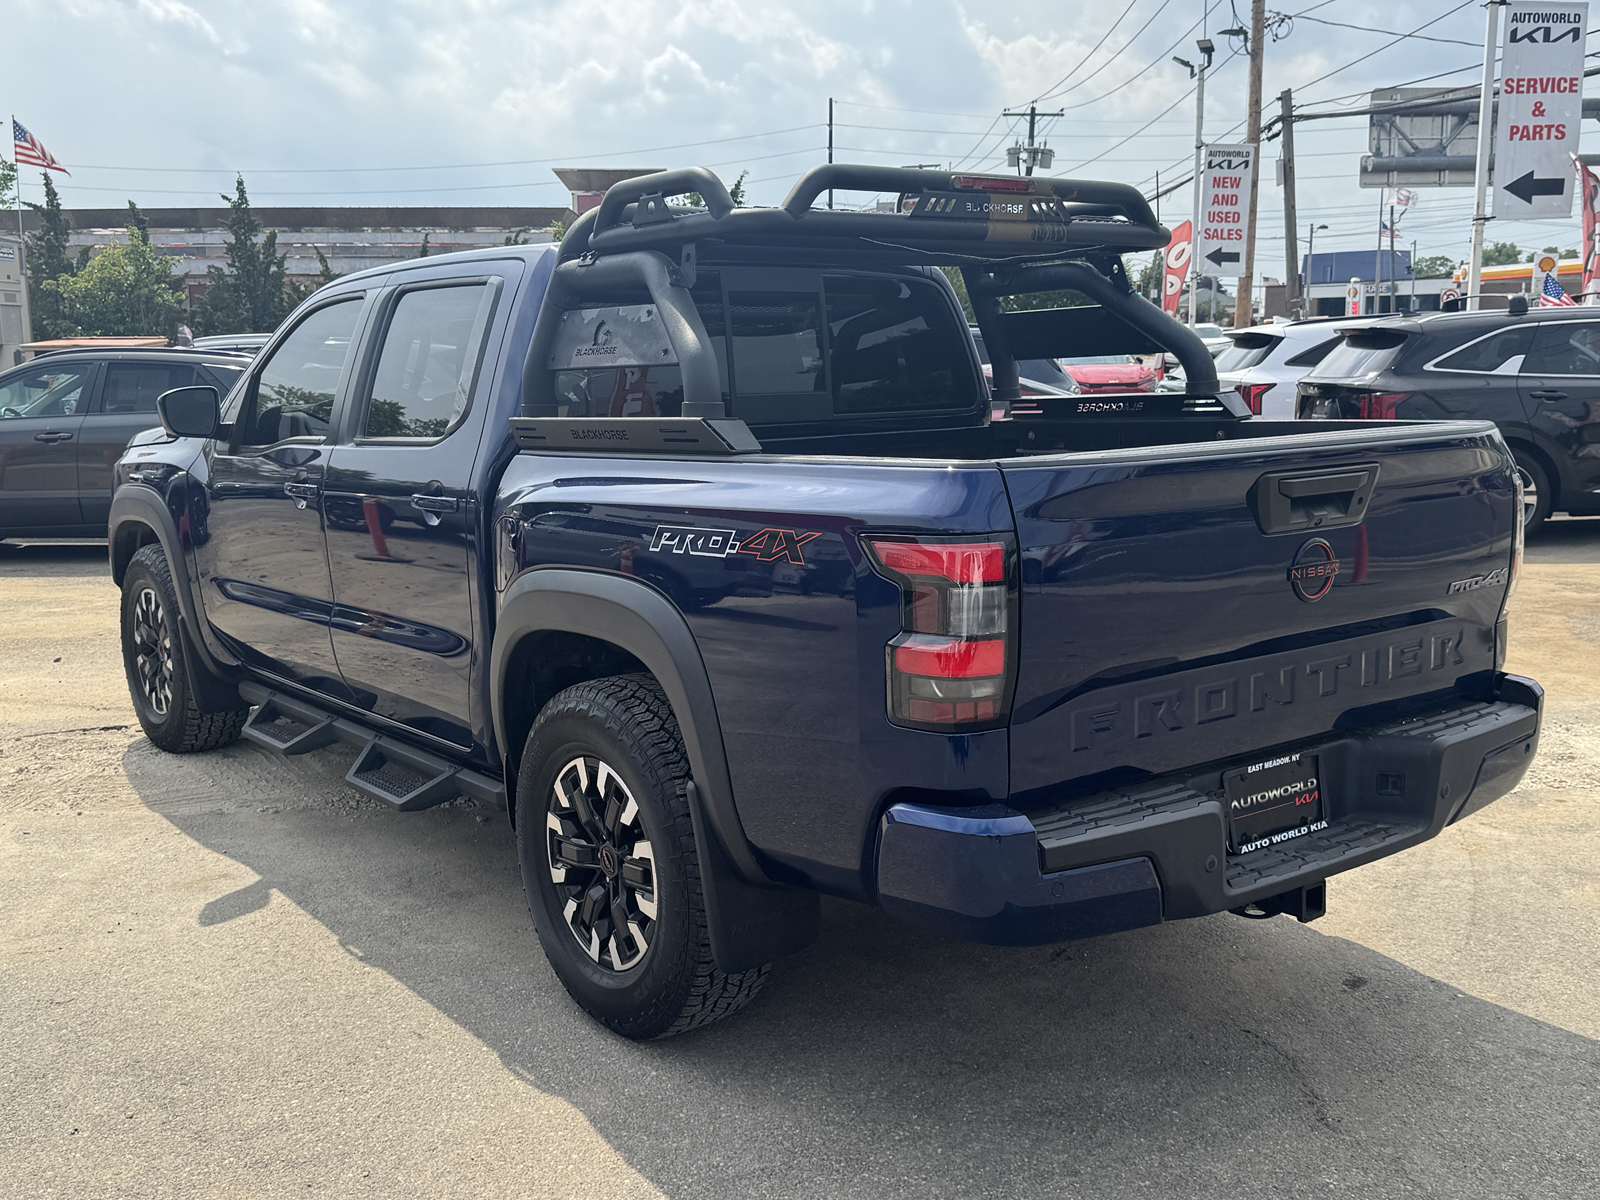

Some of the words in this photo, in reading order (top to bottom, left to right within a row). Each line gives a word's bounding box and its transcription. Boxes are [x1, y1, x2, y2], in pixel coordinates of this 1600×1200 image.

[1511, 12, 1581, 24] AUTOWORLD
[1509, 26, 1580, 43] KIA
[1504, 77, 1579, 95] SERVICE
[1531, 101, 1546, 118] &
[1509, 124, 1567, 141] PARTS
[1208, 150, 1250, 158] AUTOWORLD
[1212, 176, 1242, 189] NEW
[1211, 194, 1239, 206] AND
[1207, 211, 1240, 224] USED
[1203, 228, 1243, 240] SALES
[575, 346, 618, 357] BLACKHORSE
[571, 429, 630, 441] BLACKHORSE
[1290, 564, 1341, 579] NISSAN
[1070, 630, 1464, 752] FRONTIER
[1247, 763, 1264, 774] EAST
[1291, 753, 1301, 762] NY
[1231, 778, 1318, 810] AUTOWORLD
[1295, 790, 1319, 806] KIA
[1240, 838, 1270, 855] AUTO
[1271, 826, 1309, 844] WORLD
[1310, 820, 1329, 833] KIA
